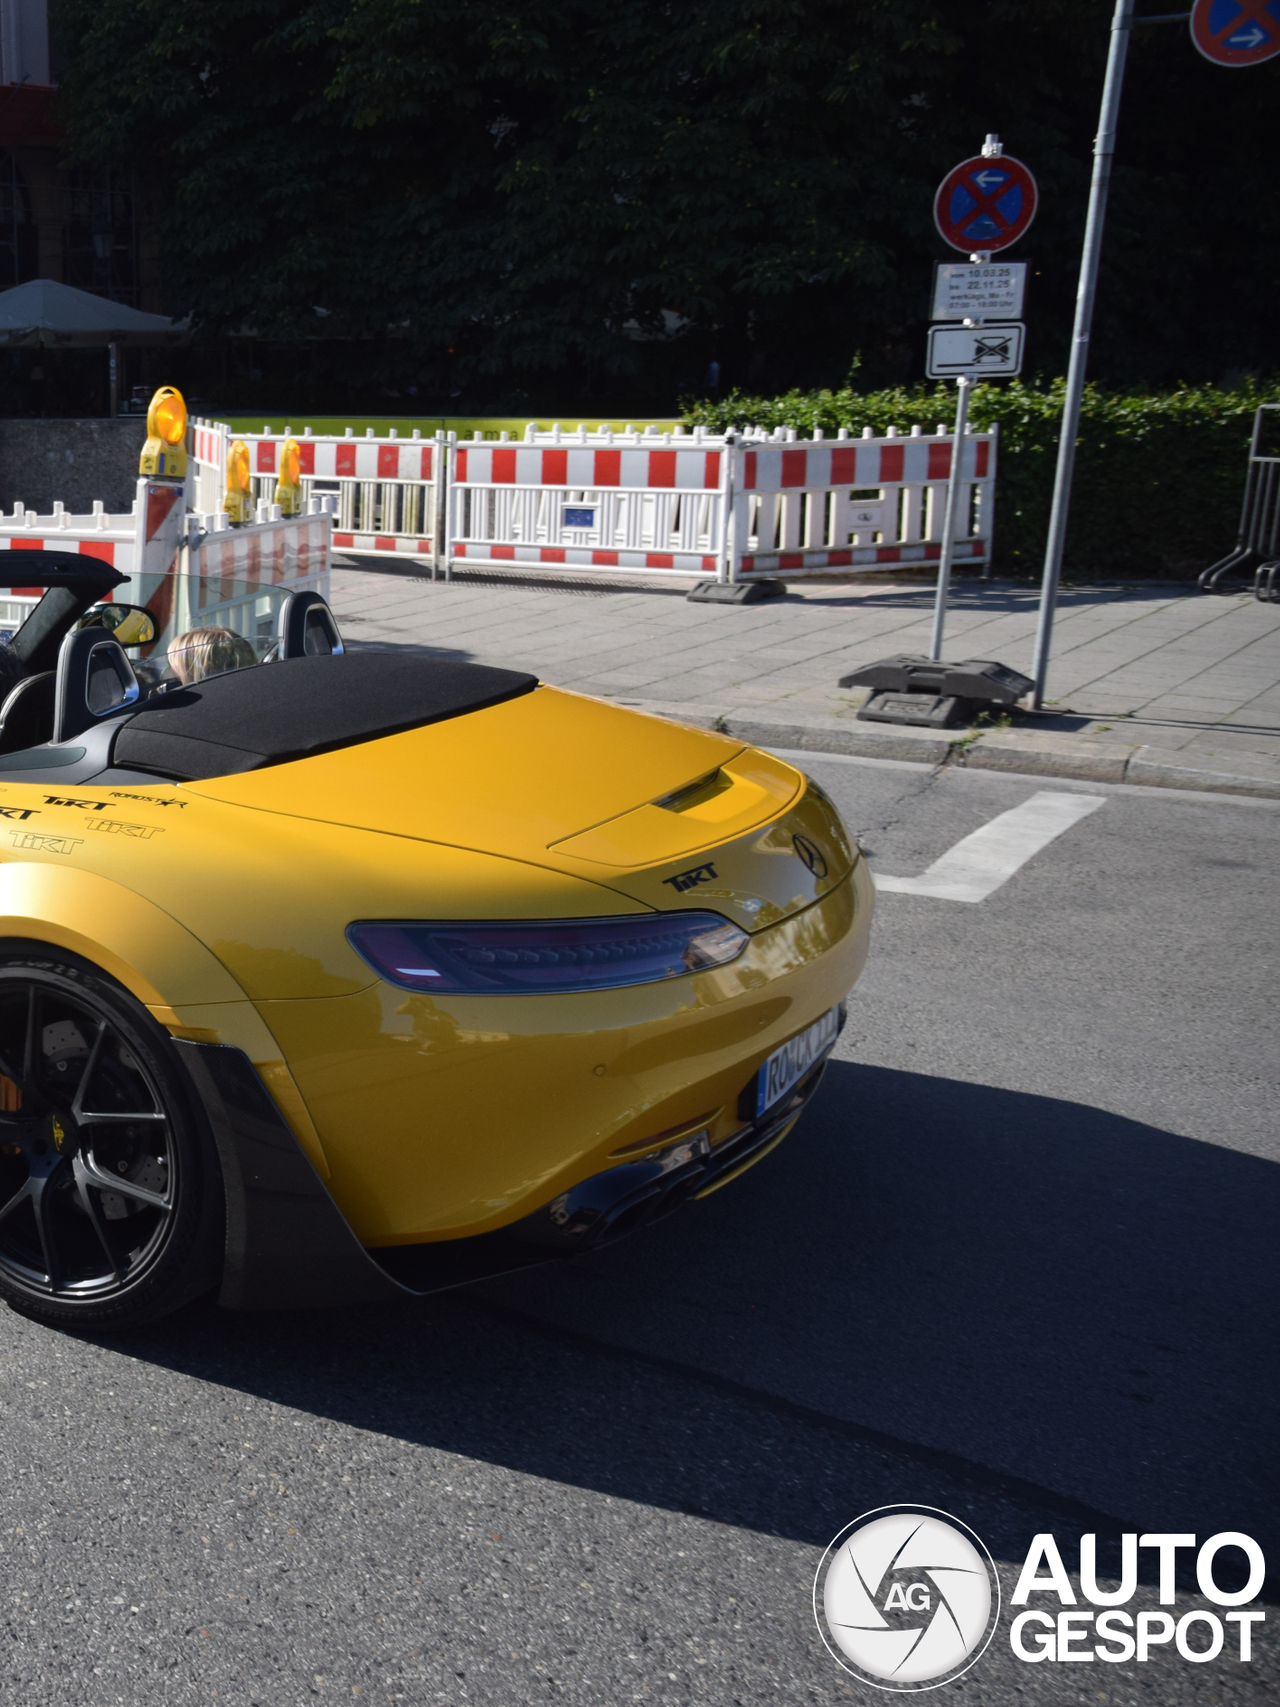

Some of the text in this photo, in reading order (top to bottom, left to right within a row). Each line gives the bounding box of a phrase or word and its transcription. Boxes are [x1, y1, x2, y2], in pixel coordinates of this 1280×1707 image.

[968, 268, 1010, 278] 10.03.25
[967, 280, 1010, 290] 22.11.25
[661, 861, 718, 892] TiKT
